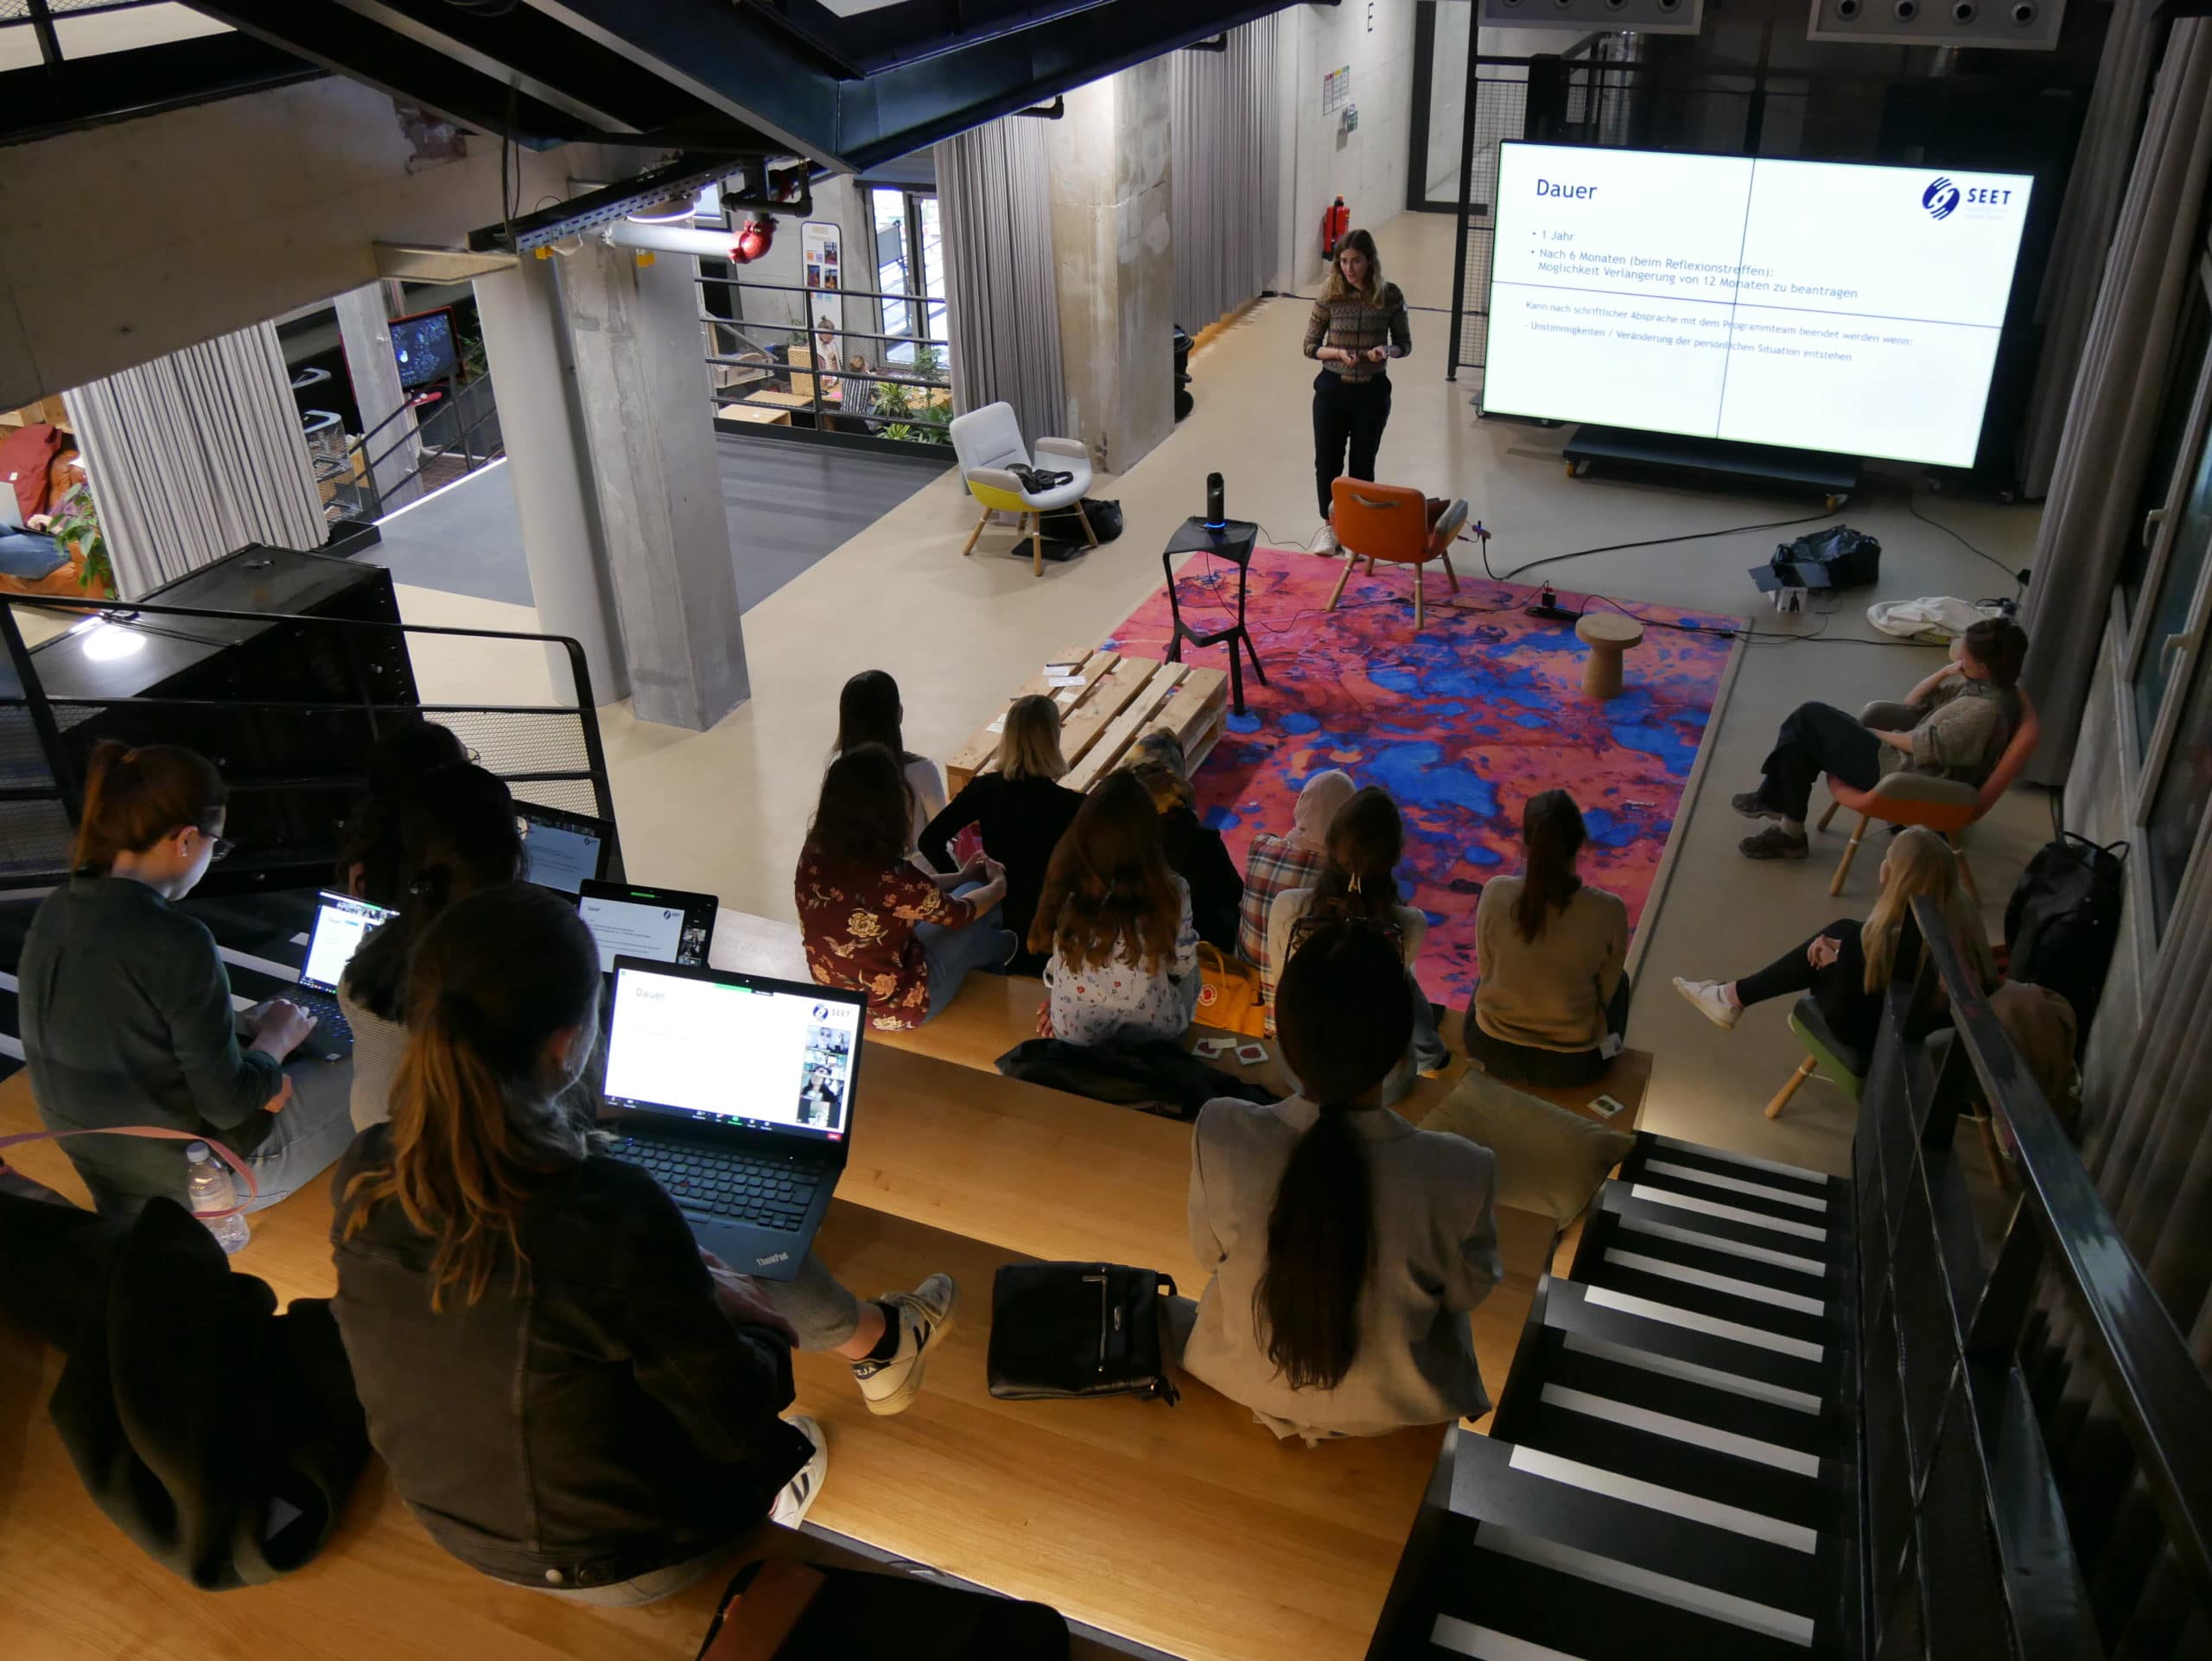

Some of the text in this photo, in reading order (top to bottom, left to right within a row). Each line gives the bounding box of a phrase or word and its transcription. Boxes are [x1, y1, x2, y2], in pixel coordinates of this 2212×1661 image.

[1536, 179, 1598, 200] Dauer
[1967, 188, 2012, 205] SEET
[1541, 230, 1574, 242] 1 Jahr
[1539, 248, 1566, 259] Nach
[1569, 251, 1576, 260] 6
[1580, 251, 1626, 265] Monaten
[1630, 256, 1662, 269] (beim
[1679, 276, 1699, 284] von
[1704, 276, 1716, 287] 12
[1719, 278, 1770, 291] Monaten
[1773, 283, 1787, 293] zu
[1790, 283, 1858, 300] beantragen
[1525, 302, 1548, 311] Kann
[1550, 305, 1571, 314] nach
[1630, 311, 1678, 324] Absprache
[1681, 317, 1696, 326] mit
[1699, 319, 1720, 328] dem
[1722, 320, 1796, 335] Programmteam
[1800, 328, 1839, 340] beendet
[1842, 332, 1879, 343] werden
[1675, 336, 1692, 347] der
[1758, 343, 1801, 357] Situation
[1803, 349, 1853, 361] entstehen
[636, 987, 666, 1002] Dauer
[755, 1251, 789, 1266] ThinkPad
